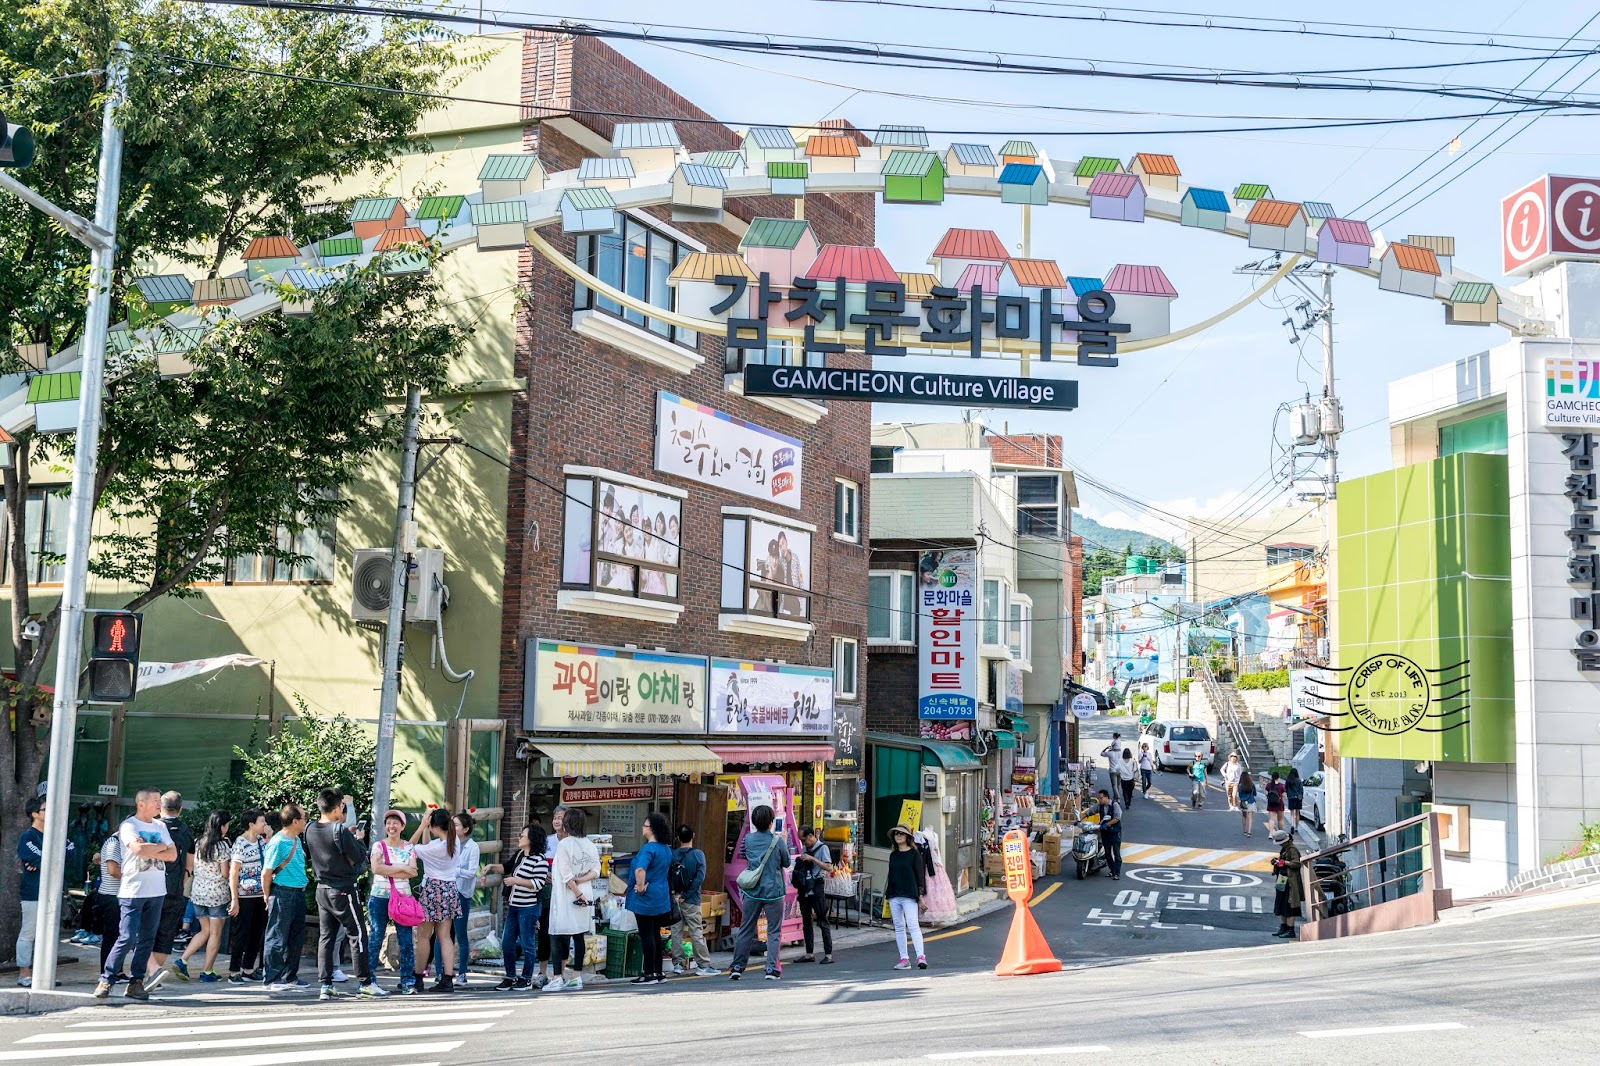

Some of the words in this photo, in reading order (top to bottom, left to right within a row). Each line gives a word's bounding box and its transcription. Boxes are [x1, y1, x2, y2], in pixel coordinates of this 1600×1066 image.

[710, 271, 1132, 367] 감천문화마을
[772, 369, 904, 394] GAMCHEON
[910, 375, 984, 399] Culture
[987, 379, 1055, 403] Village
[1547, 413, 1581, 423] Culture
[1561, 433, 1600, 671] 감천문화마을
[941, 575, 956, 584] MH
[924, 589, 972, 606] 문화마을
[930, 608, 965, 689] 할인마트
[553, 660, 631, 707] 과일이랑
[790, 691, 820, 727] 치킨
[929, 697, 969, 706] 신속배달
[923, 706, 973, 715] 204-0793
[1006, 855, 1023, 871] 진입
[1008, 873, 1026, 889] 금지
[1145, 870, 1242, 885] 30
[1113, 889, 1263, 913] 어린이
